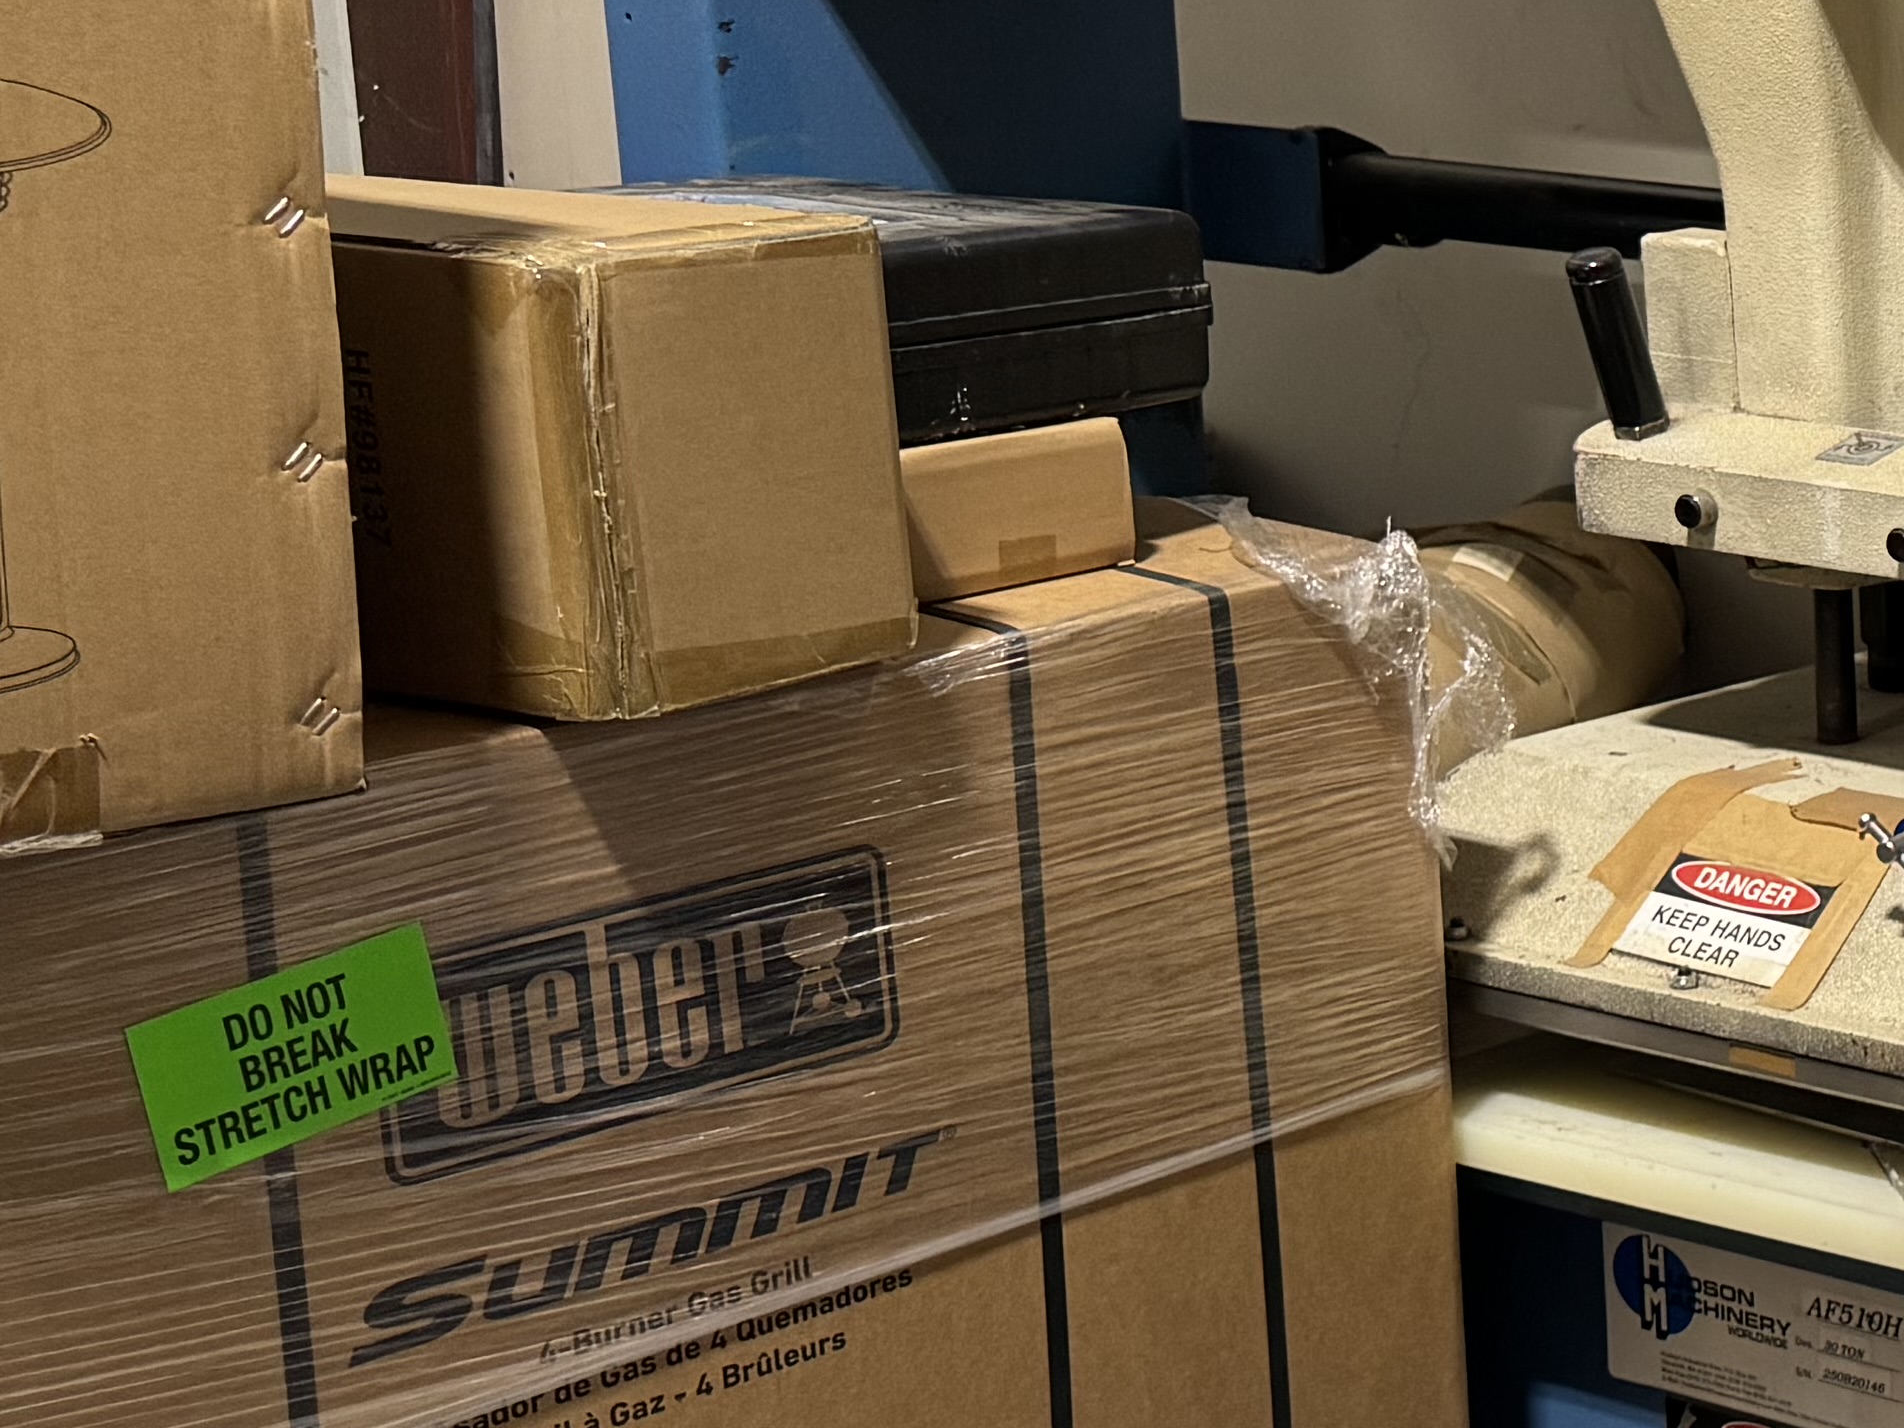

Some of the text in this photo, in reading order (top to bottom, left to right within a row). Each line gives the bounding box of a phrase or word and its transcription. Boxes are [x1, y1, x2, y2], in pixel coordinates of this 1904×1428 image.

[346, 348, 392, 549] HF#98137
[1652, 905, 1786, 951] KEEP HANDS
[1694, 867, 1797, 908] DANGER
[1668, 937, 1739, 968] CLEAR
[221, 974, 348, 1051] DO NOT
[441, 920, 766, 1127] weber
[173, 1073, 334, 1164] STRETCH
[345, 1036, 436, 1102] WRAP
[239, 1030, 359, 1094] BREAK
[539, 1256, 813, 1365] 4-Burner Gas Grill
[554, 1367, 592, 1404] de
[600, 1354, 657, 1389] Gas
[666, 1336, 701, 1366] de
[710, 1329, 727, 1350] 4
[736, 1269, 914, 1340] Quemadores
[1807, 1297, 1903, 1337] AF510H
[610, 1394, 666, 1427] Gaz
[696, 1374, 713, 1397] 4
[723, 1332, 846, 1389] Brûleurs
